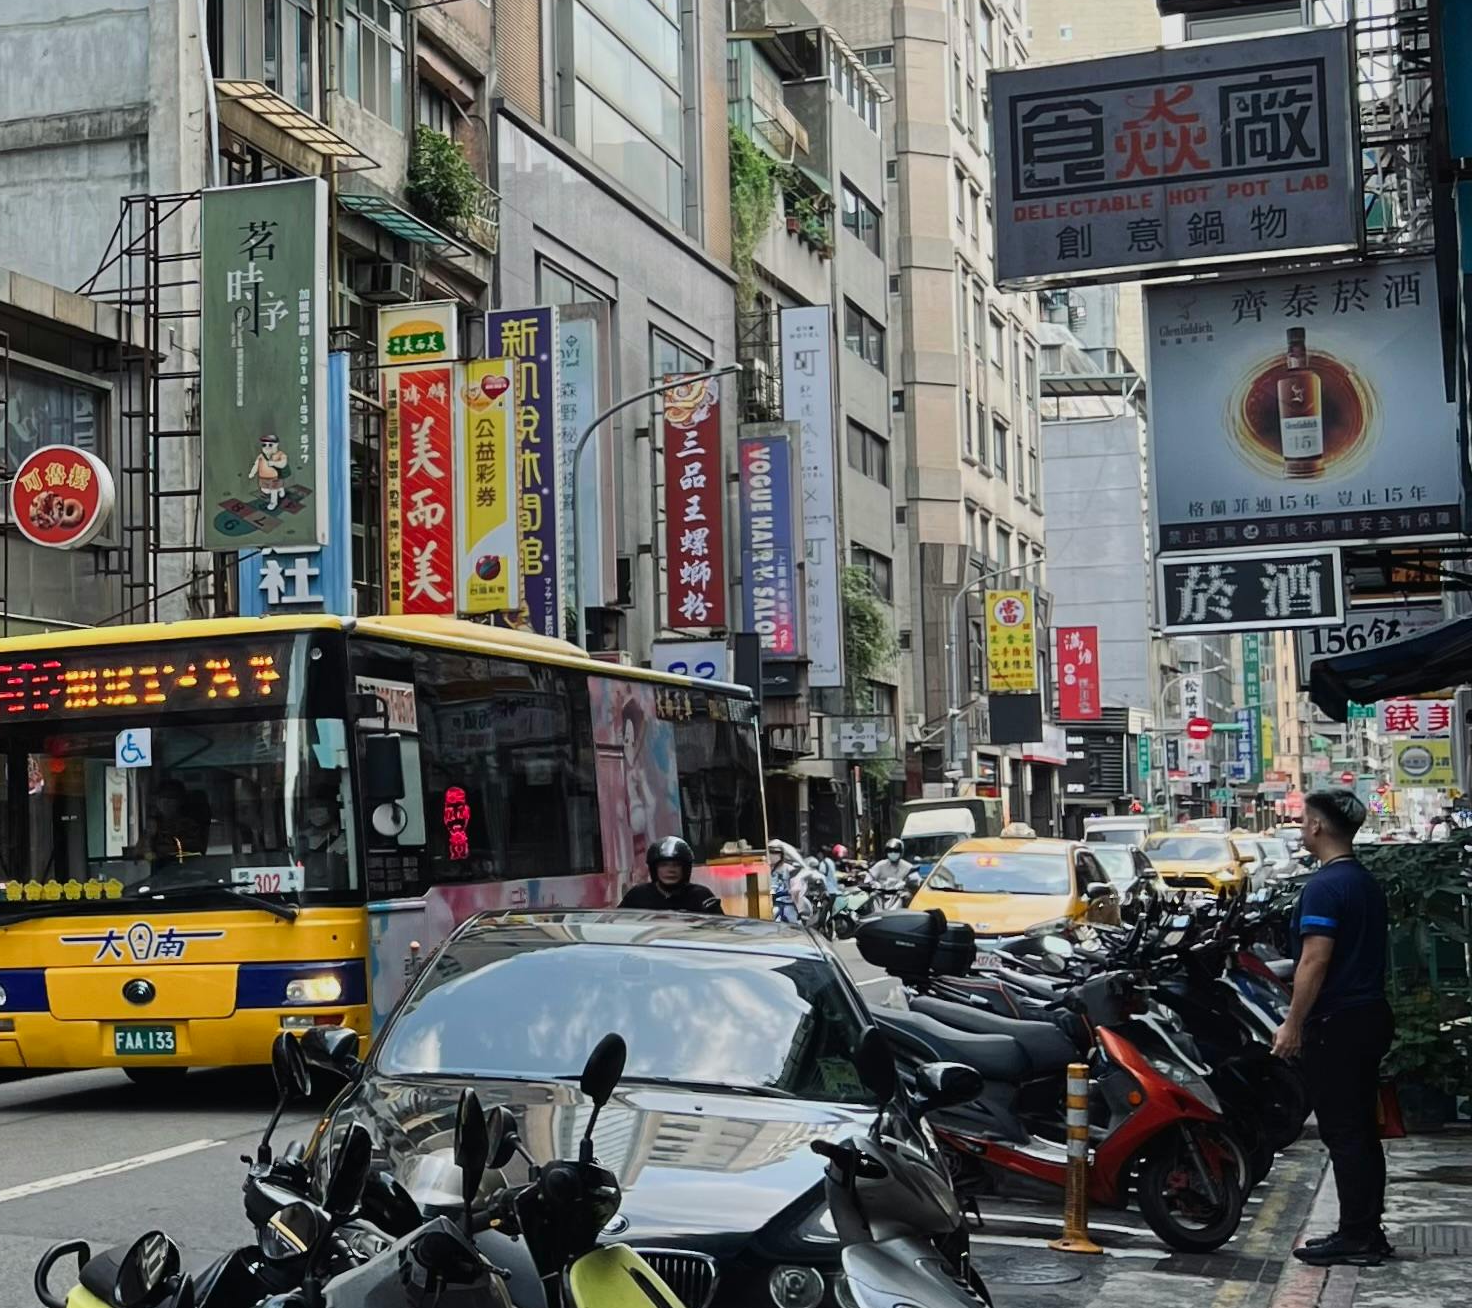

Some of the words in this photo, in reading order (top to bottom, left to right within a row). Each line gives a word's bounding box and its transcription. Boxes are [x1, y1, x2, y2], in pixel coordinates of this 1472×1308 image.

[1014, 192, 1152, 221] DELECTABLE
[1169, 184, 1209, 206] HOT
[1228, 180, 1268, 200] POT
[1286, 174, 1329, 195] LAB
[1056, 205, 1288, 261] 創意鍋物
[1232, 272, 1422, 325] 齊泰菸酒
[475, 418, 497, 507] 公益彩券
[748, 447, 772, 512] VOGUE
[406, 416, 446, 603] 美而美
[676, 430, 713, 622] 三品王螺螄粉
[750, 517, 773, 563] HAIR
[258, 547, 325, 605] 社
[1176, 560, 1321, 622] 菸酒
[753, 584, 776, 649] SALON
[255, 874, 280, 893] 302
[115, 1031, 174, 1051] FAA-133
